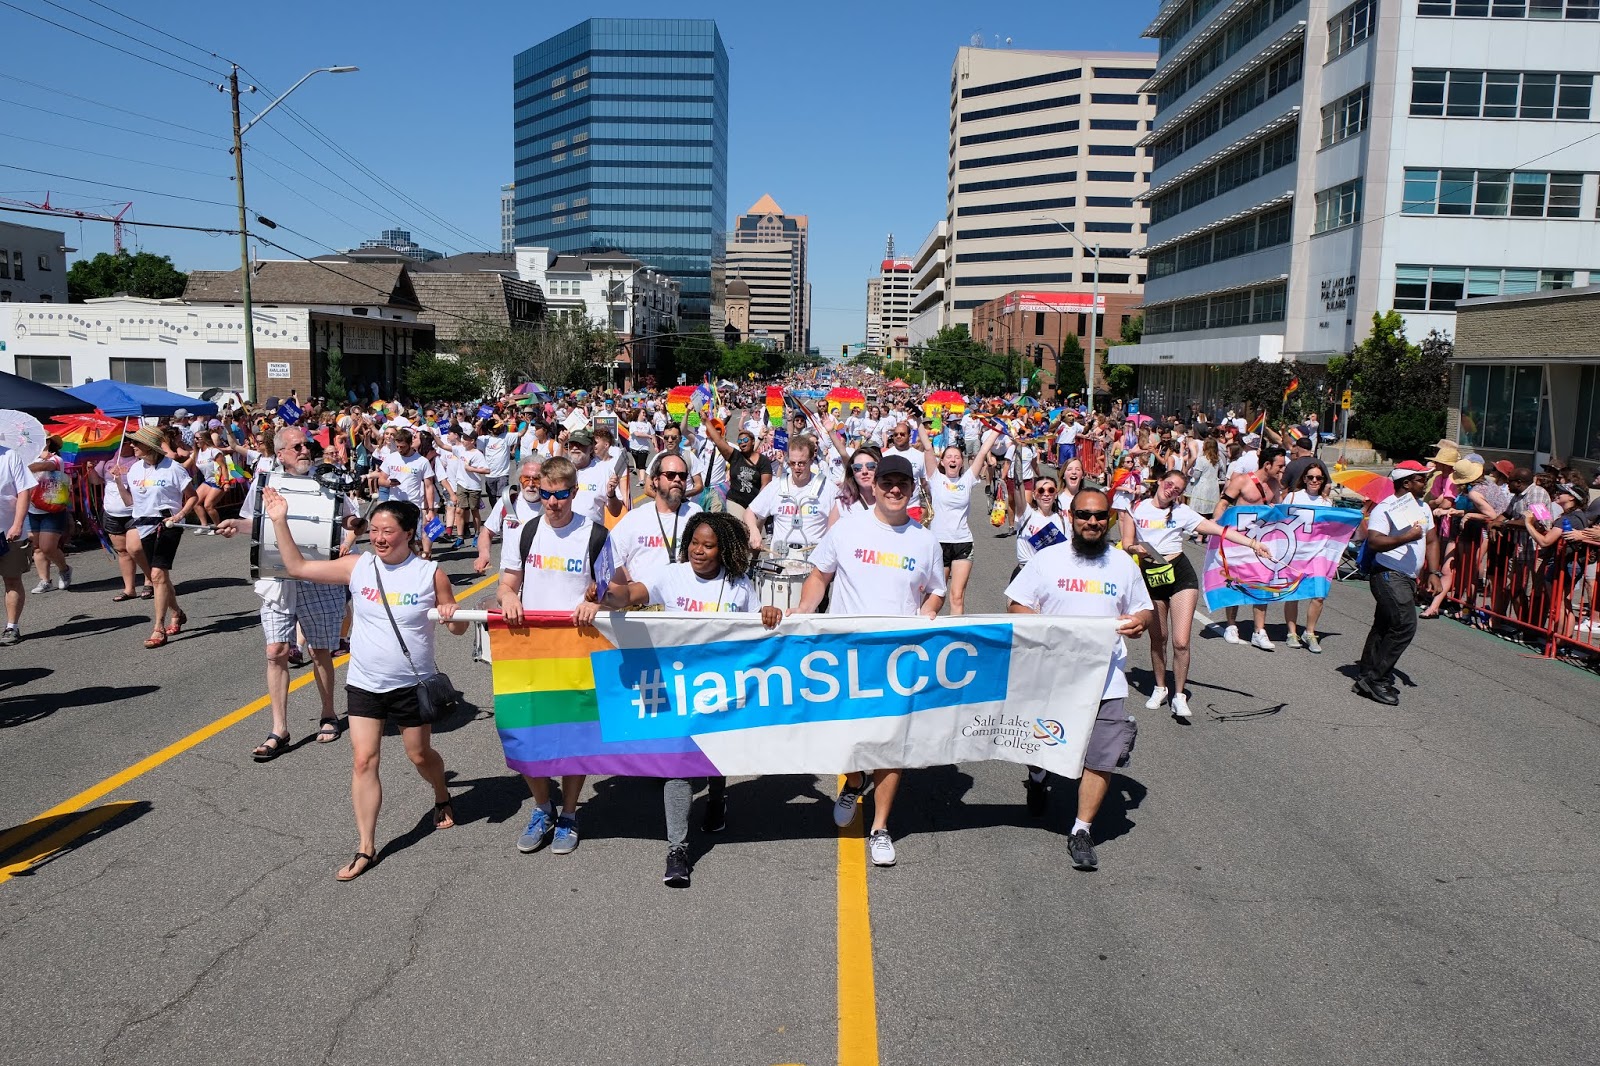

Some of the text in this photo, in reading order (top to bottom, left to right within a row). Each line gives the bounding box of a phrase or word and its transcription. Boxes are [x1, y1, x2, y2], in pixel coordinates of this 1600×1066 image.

[778, 505, 818, 515] #IAMCC
[638, 536, 682, 548] #IAMC
[526, 553, 583, 573] #IAMSLCC
[854, 548, 916, 571] #IAMSLCC
[1149, 573, 1171, 586] PINK
[677, 597, 738, 612] #IAMCC
[631, 641, 979, 719] #iamSLCC
[973, 714, 1030, 728] Salt Lake
[962, 725, 1031, 740] Community
[993, 735, 1041, 754] College
